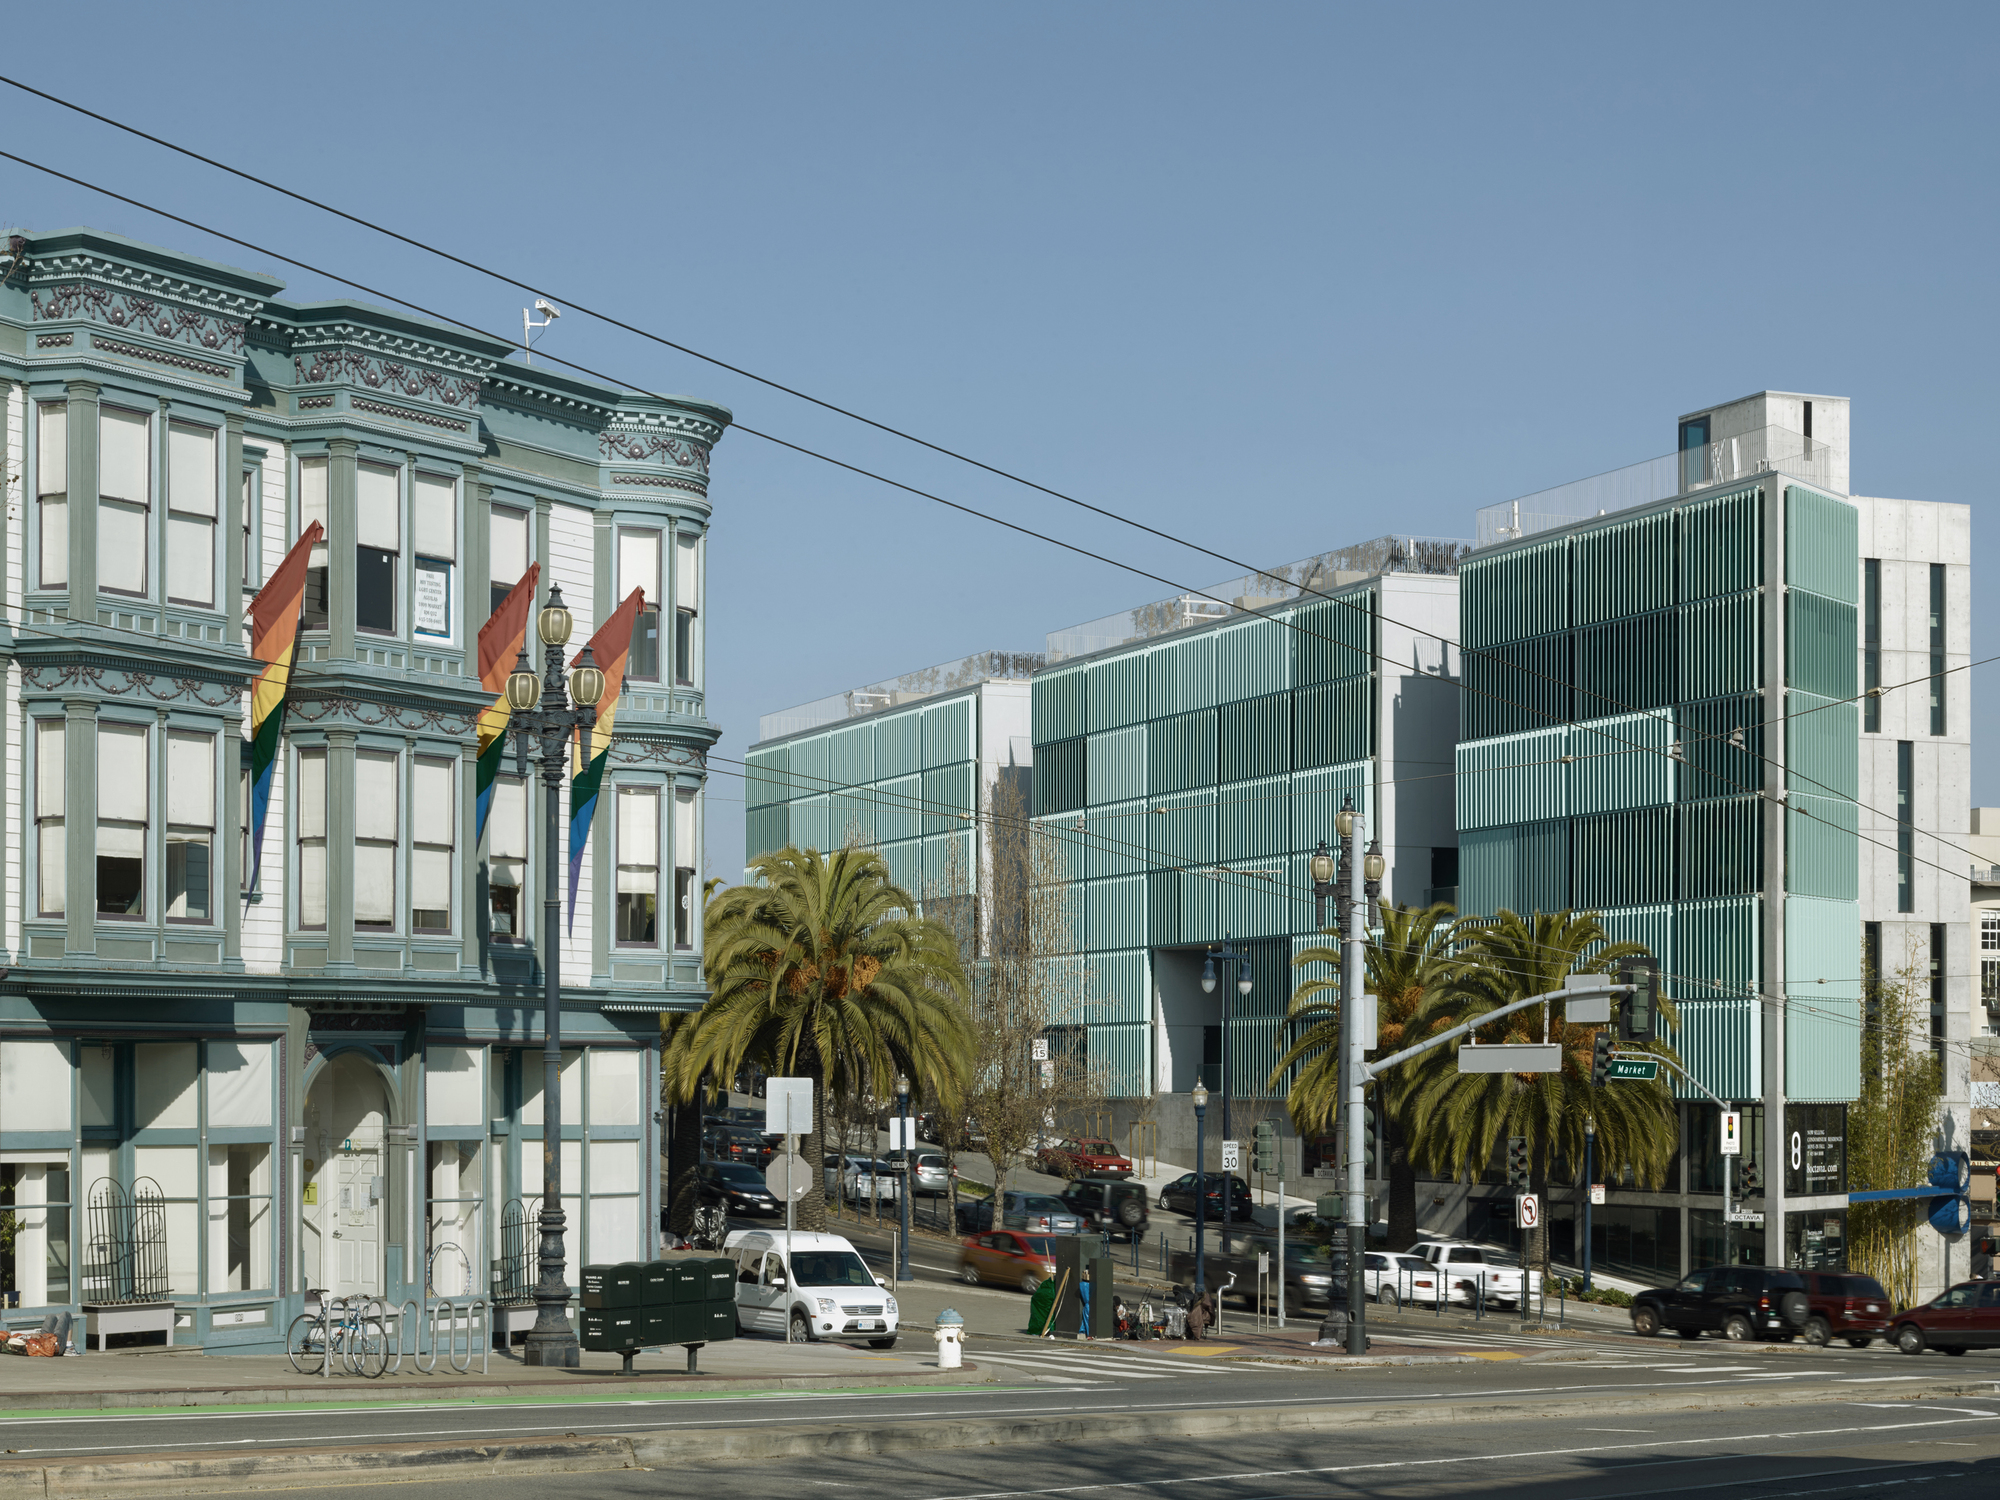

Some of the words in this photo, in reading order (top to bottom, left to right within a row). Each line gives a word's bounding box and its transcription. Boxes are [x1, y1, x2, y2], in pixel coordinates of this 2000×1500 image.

[1034, 1050, 1045, 1058] 15
[1617, 1064, 1646, 1074] Market
[1792, 1131, 1801, 1170] 8
[1224, 1157, 1237, 1168] 30
